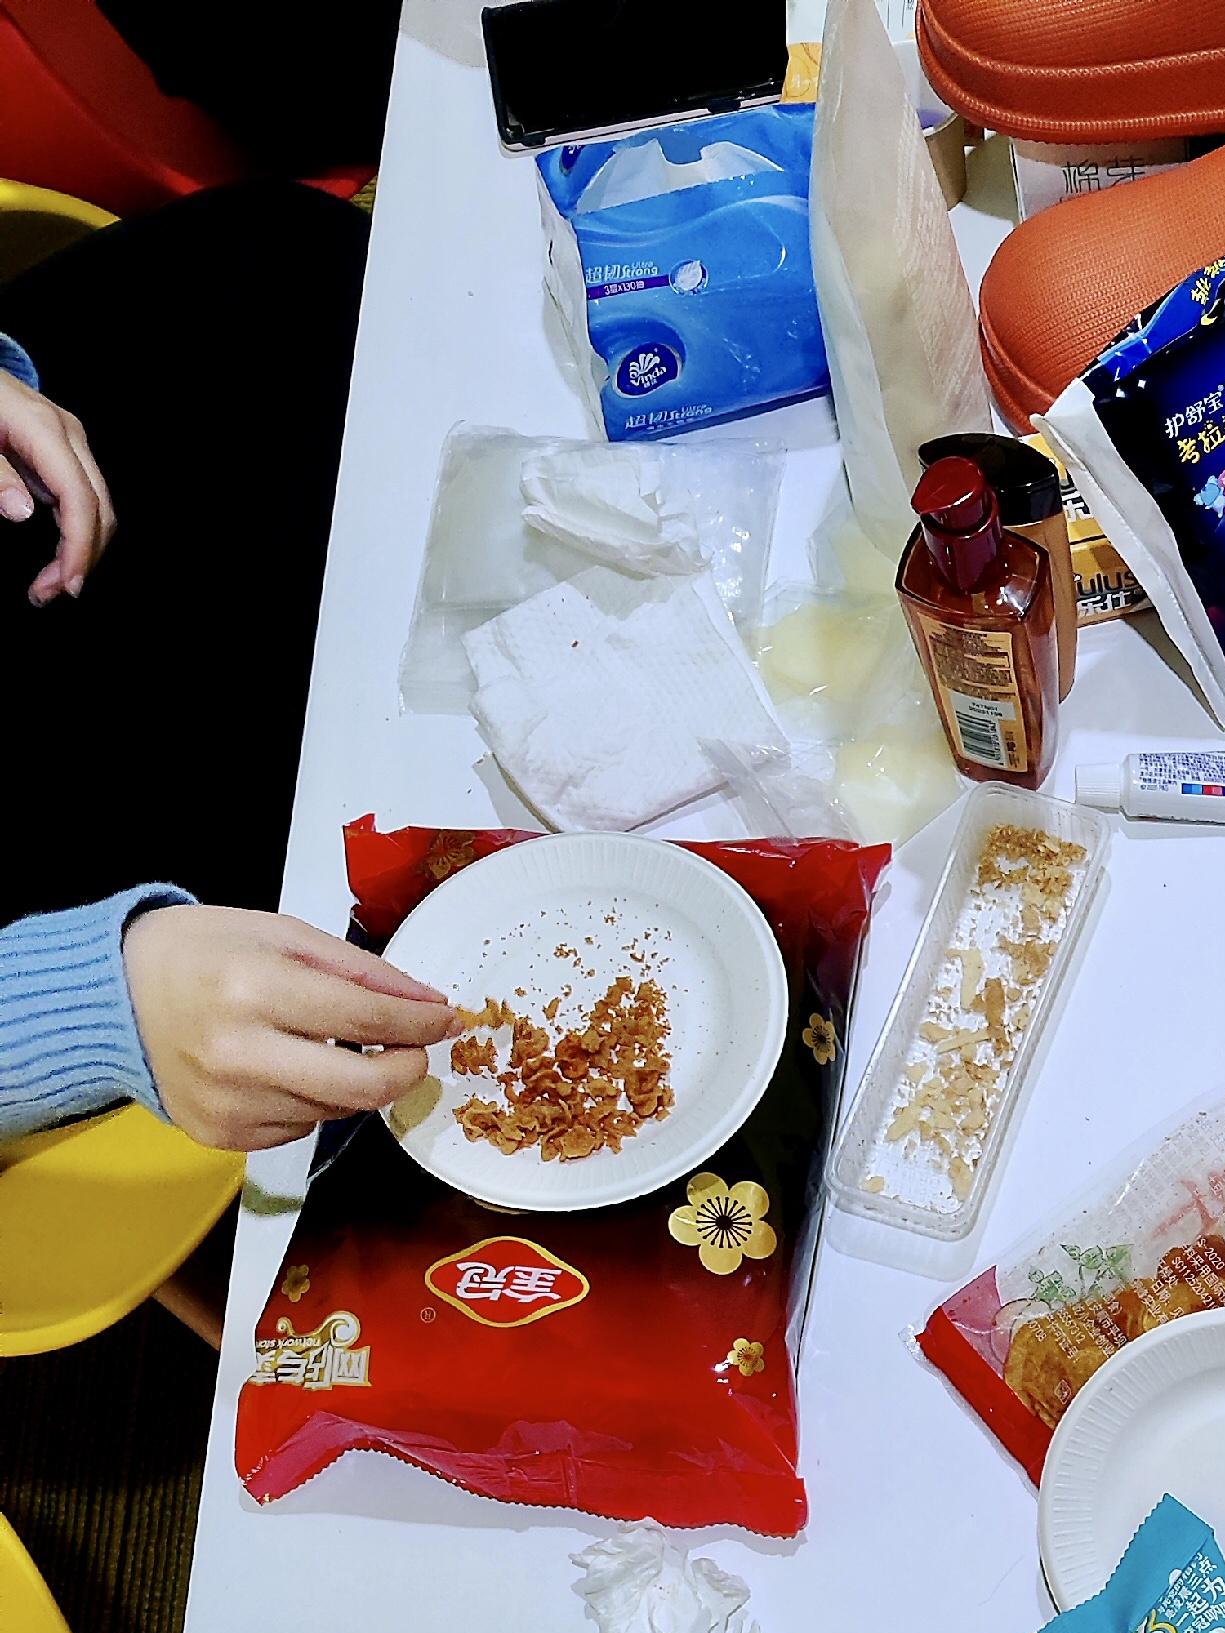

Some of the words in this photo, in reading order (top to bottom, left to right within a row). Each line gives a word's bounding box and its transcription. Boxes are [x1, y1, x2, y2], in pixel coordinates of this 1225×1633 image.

[630, 366, 667, 386] Vinda
[1165, 392, 1224, 438] 护舒宝
[455, 1261, 562, 1302] 金冠
